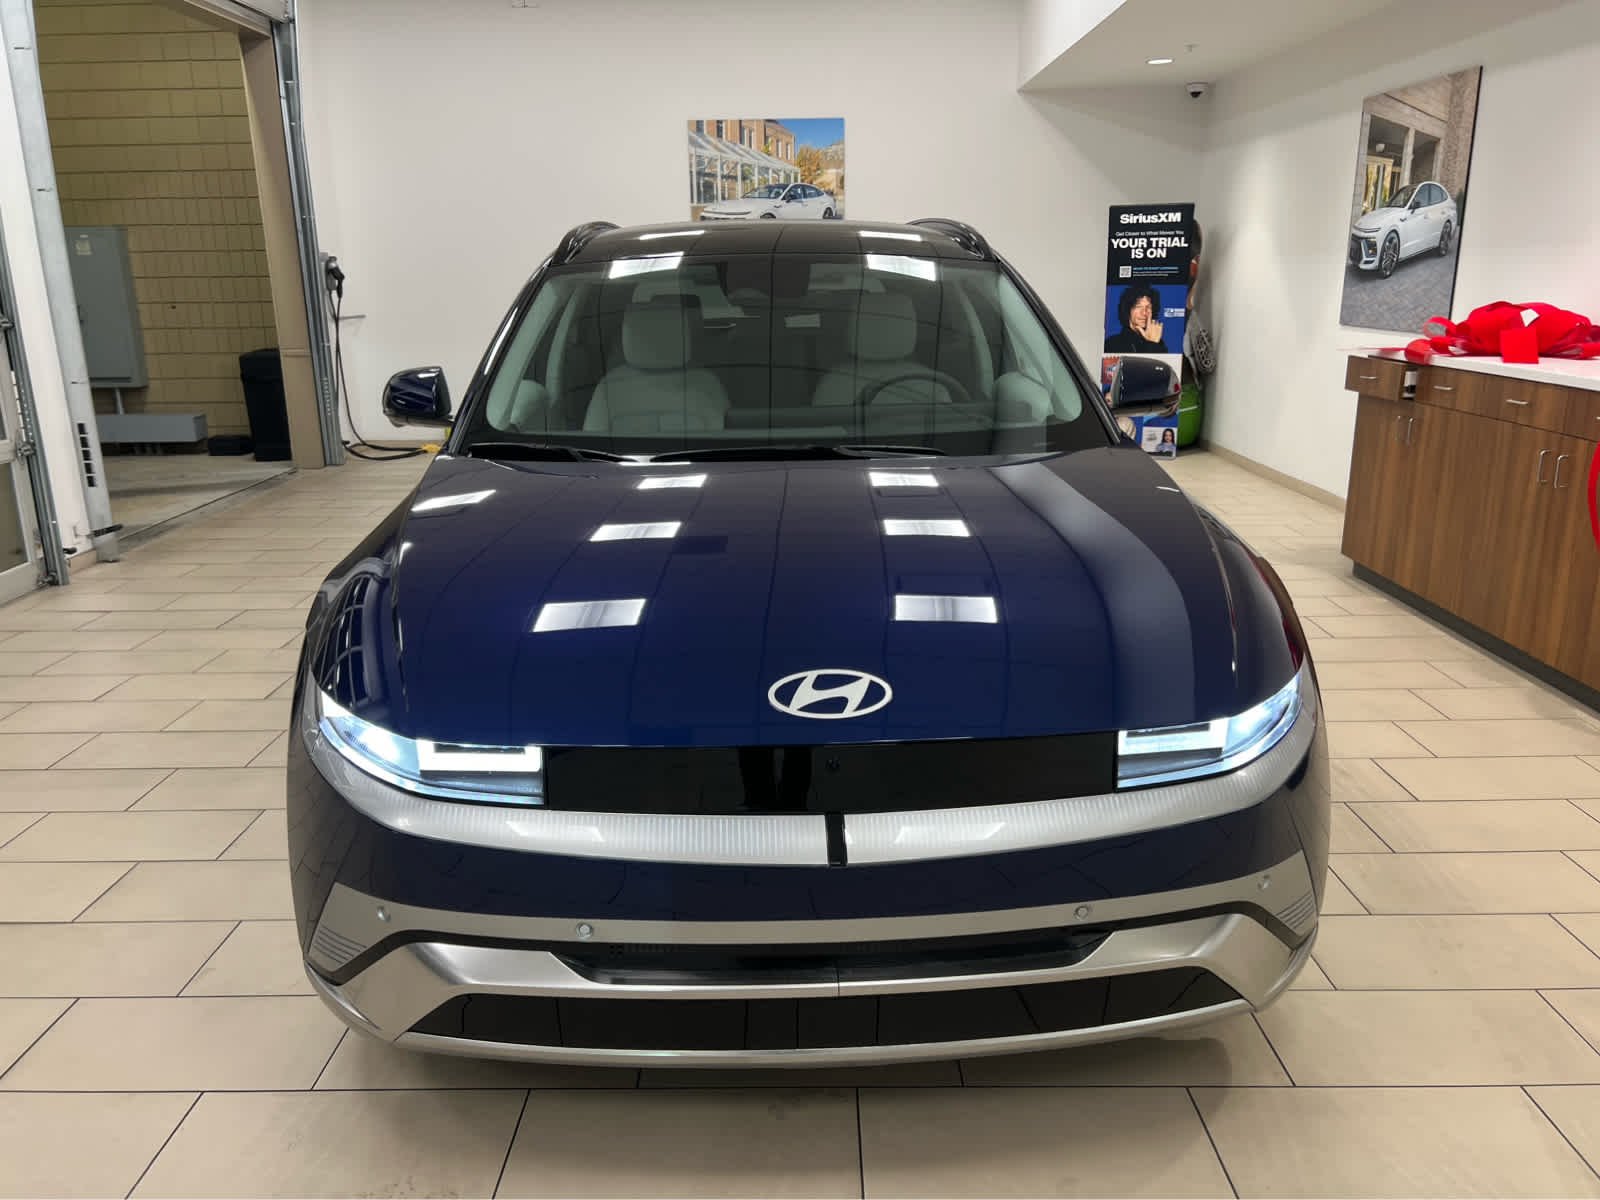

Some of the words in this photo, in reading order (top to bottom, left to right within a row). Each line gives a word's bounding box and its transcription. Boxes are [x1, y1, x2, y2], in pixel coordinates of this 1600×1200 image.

[1120, 212, 1181, 224] SiriusXM
[1111, 238, 1148, 249] YOUR
[1150, 237, 1189, 248] TRIAL
[1131, 248, 1144, 259] IS
[1146, 248, 1167, 258] ON
